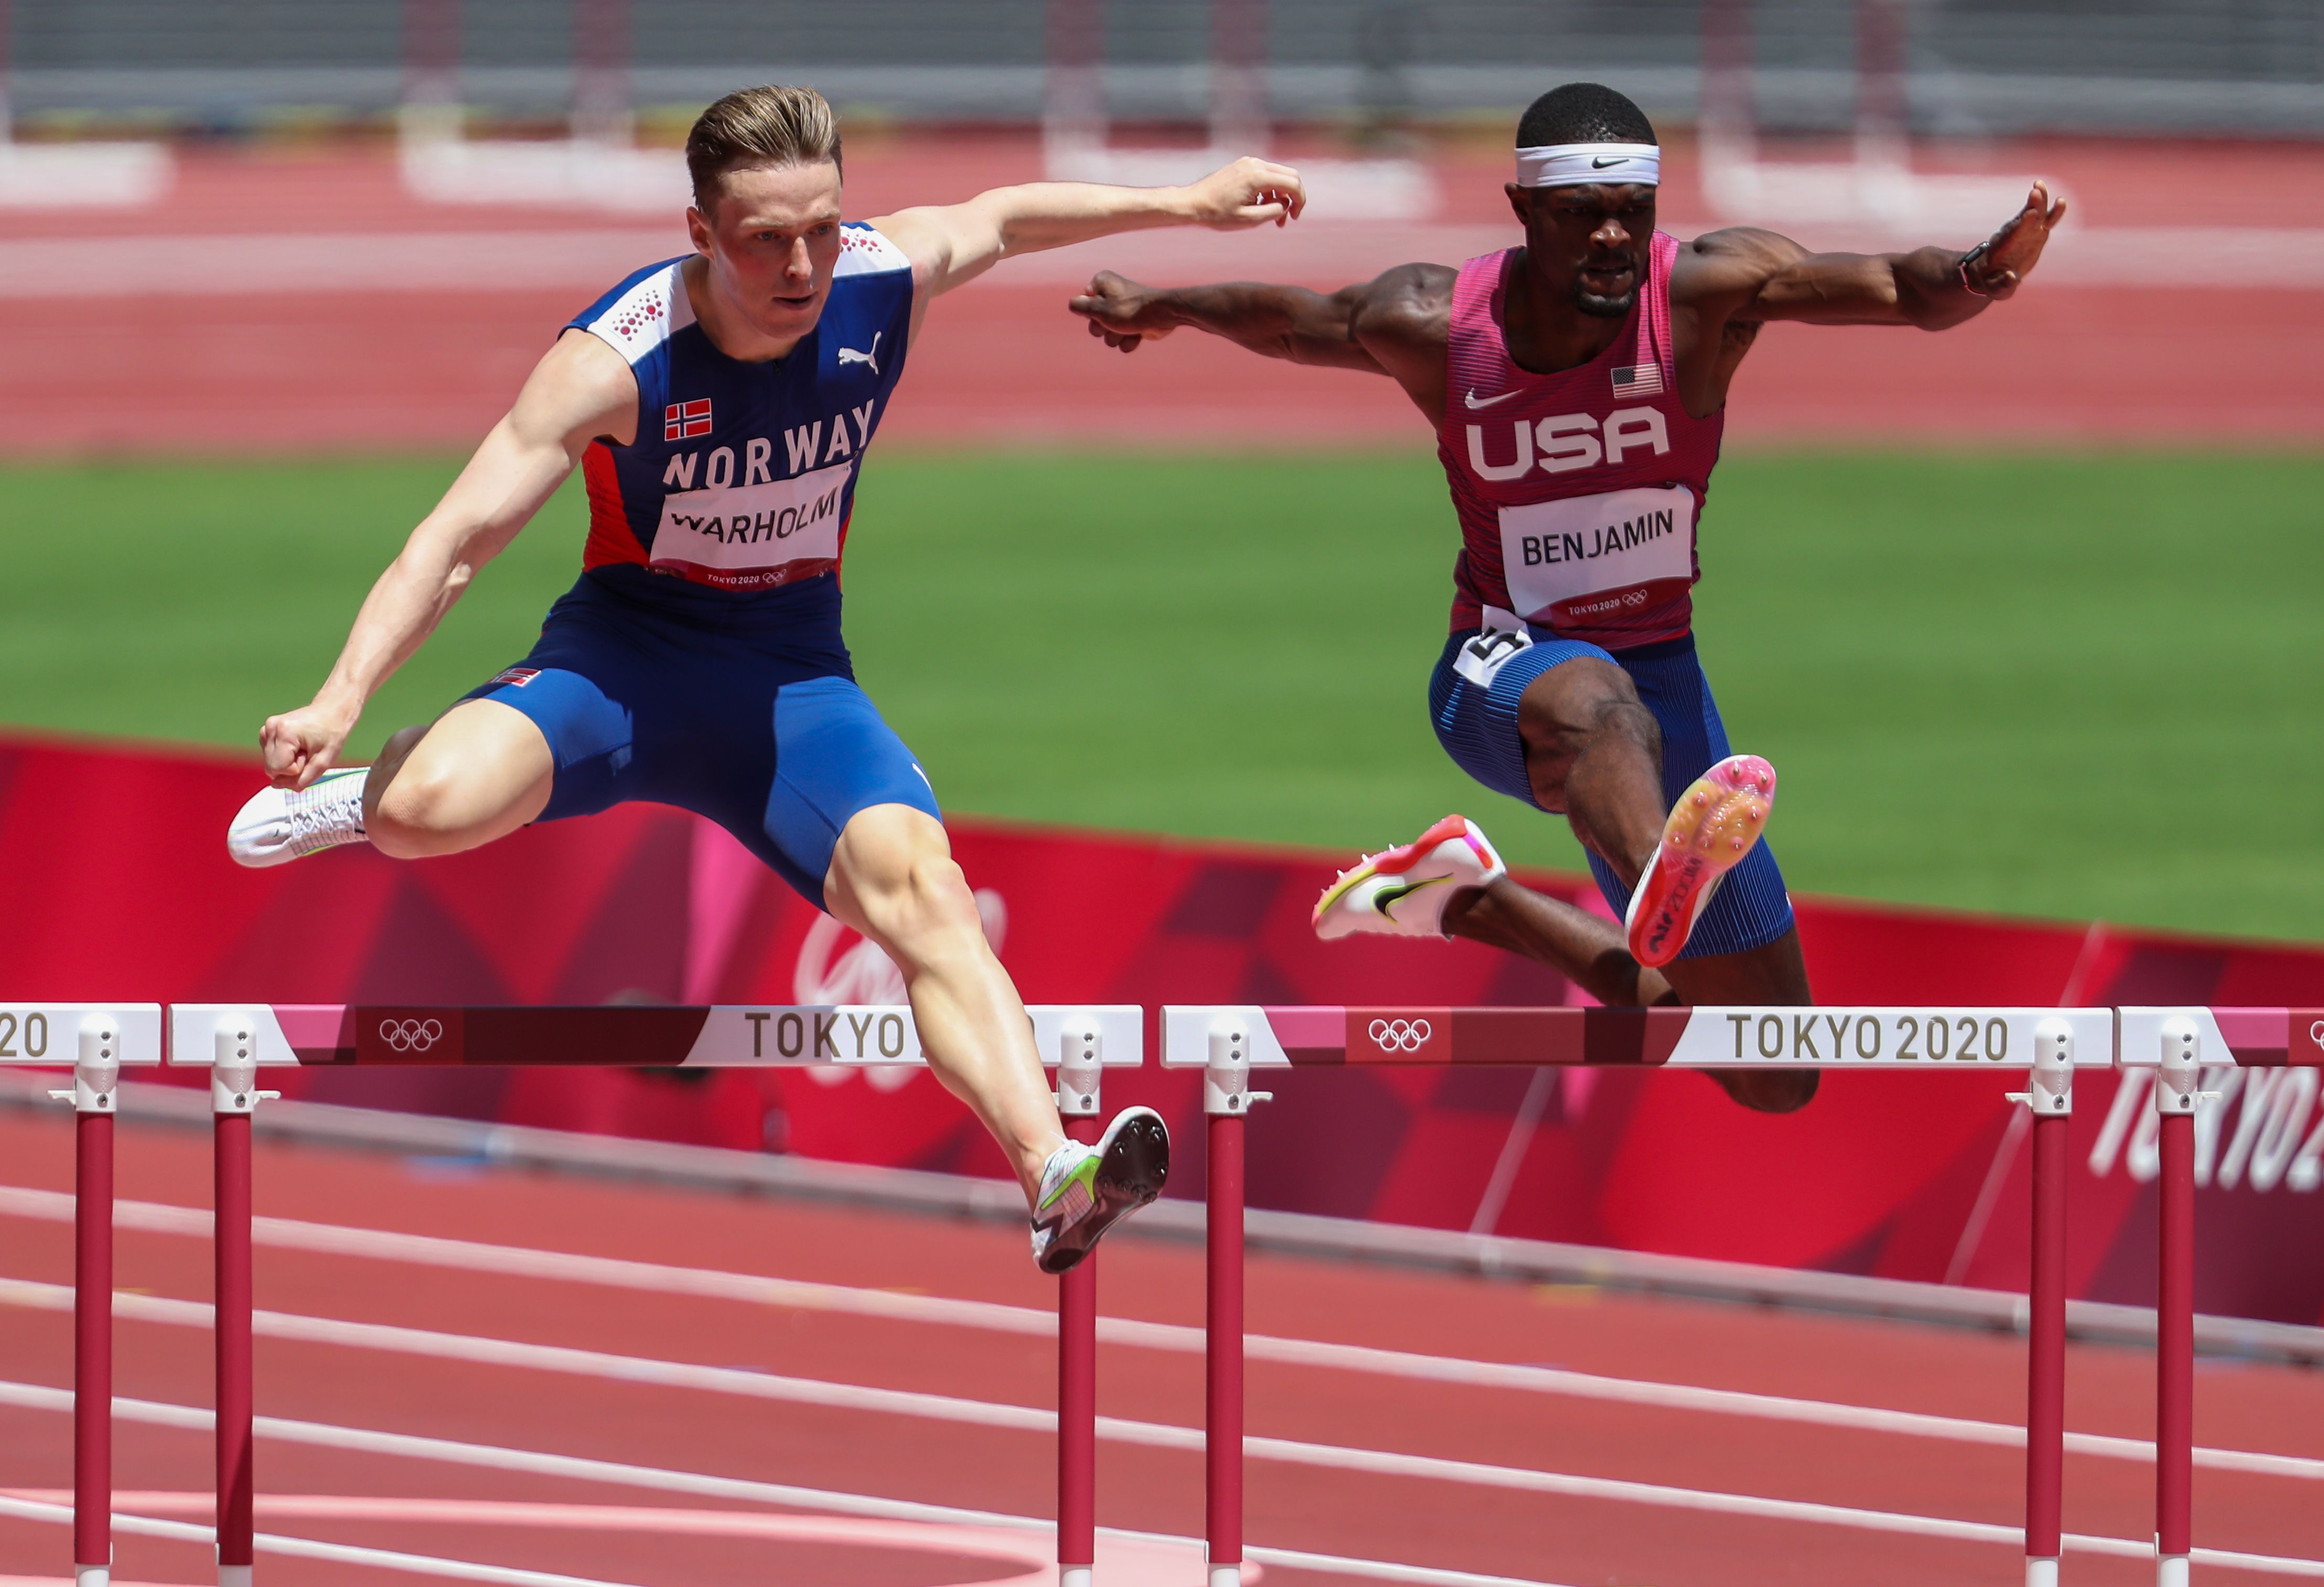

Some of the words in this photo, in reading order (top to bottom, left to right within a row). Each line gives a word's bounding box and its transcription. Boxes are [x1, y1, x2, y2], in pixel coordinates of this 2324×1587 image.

[662, 398, 874, 489] NORWAY
[1466, 406, 1670, 481] USA
[671, 485, 838, 544] WARHOLM
[1522, 508, 1673, 566] BENJAMIN
[708, 573, 736, 584] TOKYO
[738, 575, 759, 584] 2020
[1569, 603, 1598, 615] TOKYO
[1599, 598, 1620, 611] 2020
[745, 1013, 904, 1058] TOKYO
[1726, 1014, 1881, 1059] TOKYO
[1896, 1016, 2008, 1061] 2020
